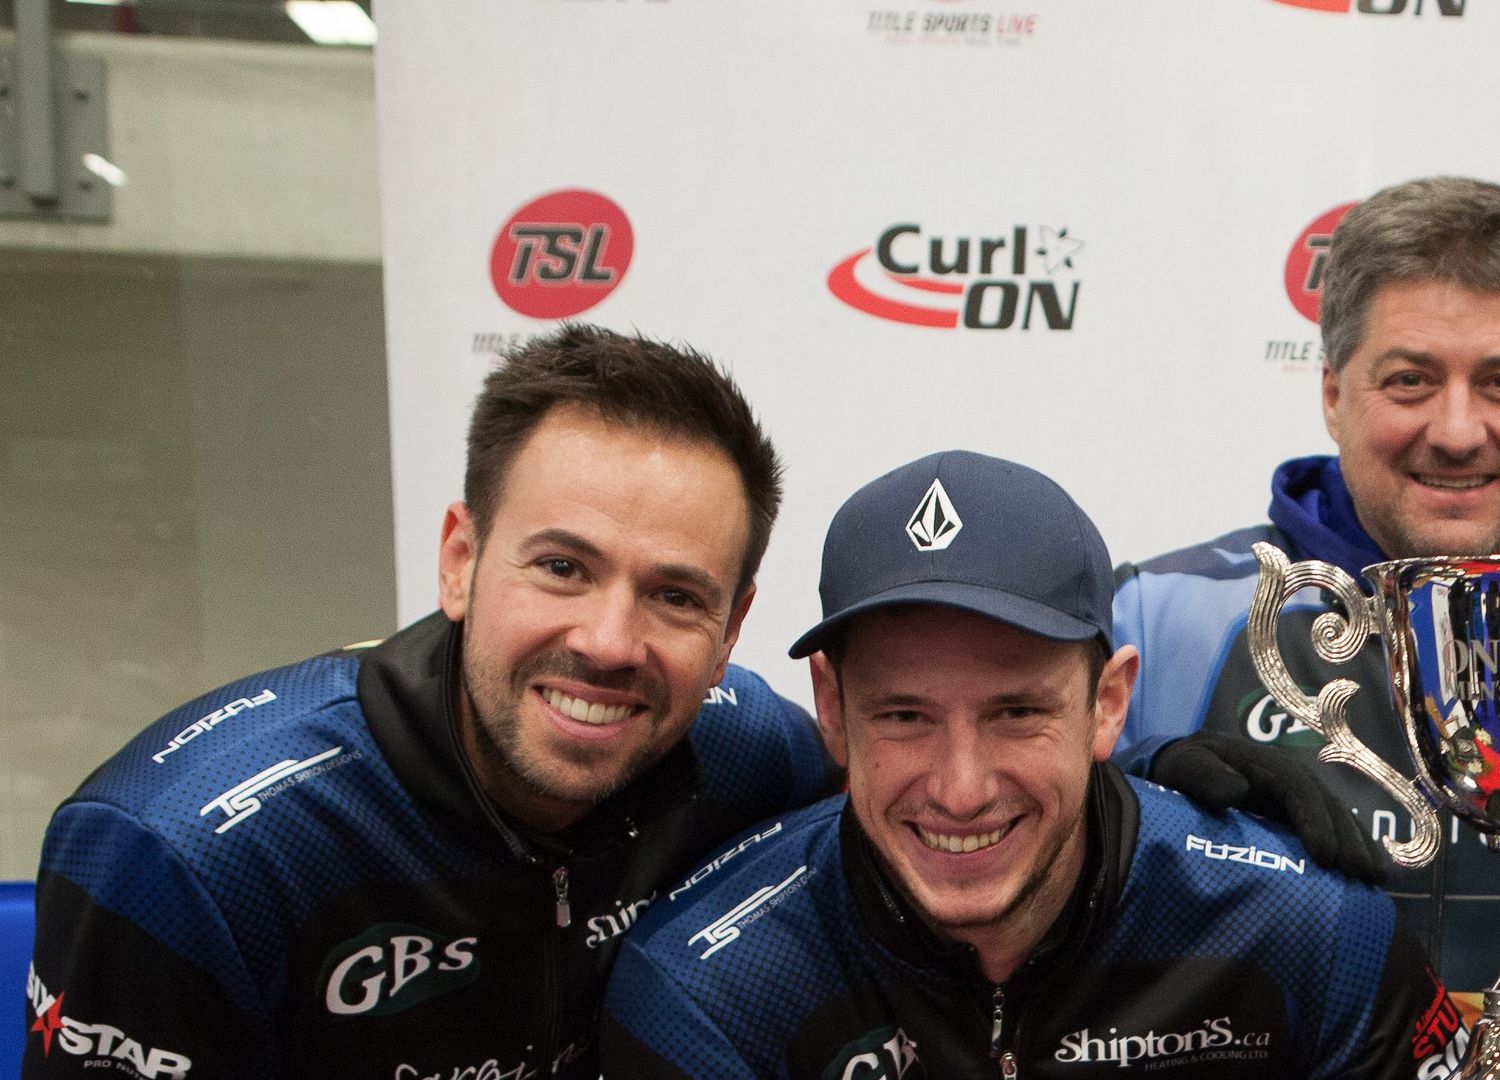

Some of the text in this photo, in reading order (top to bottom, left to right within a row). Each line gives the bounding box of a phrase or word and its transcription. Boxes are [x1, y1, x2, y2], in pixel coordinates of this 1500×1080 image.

[867, 10, 1038, 35] TITLE SPORTS LIVE
[509, 223, 616, 285] TSL
[876, 223, 1027, 276] Curl
[963, 280, 1081, 331] ON
[1264, 341, 1312, 360] TITLE
[1186, 834, 1306, 875] FUZION
[58, 1015, 193, 1080] STAR
